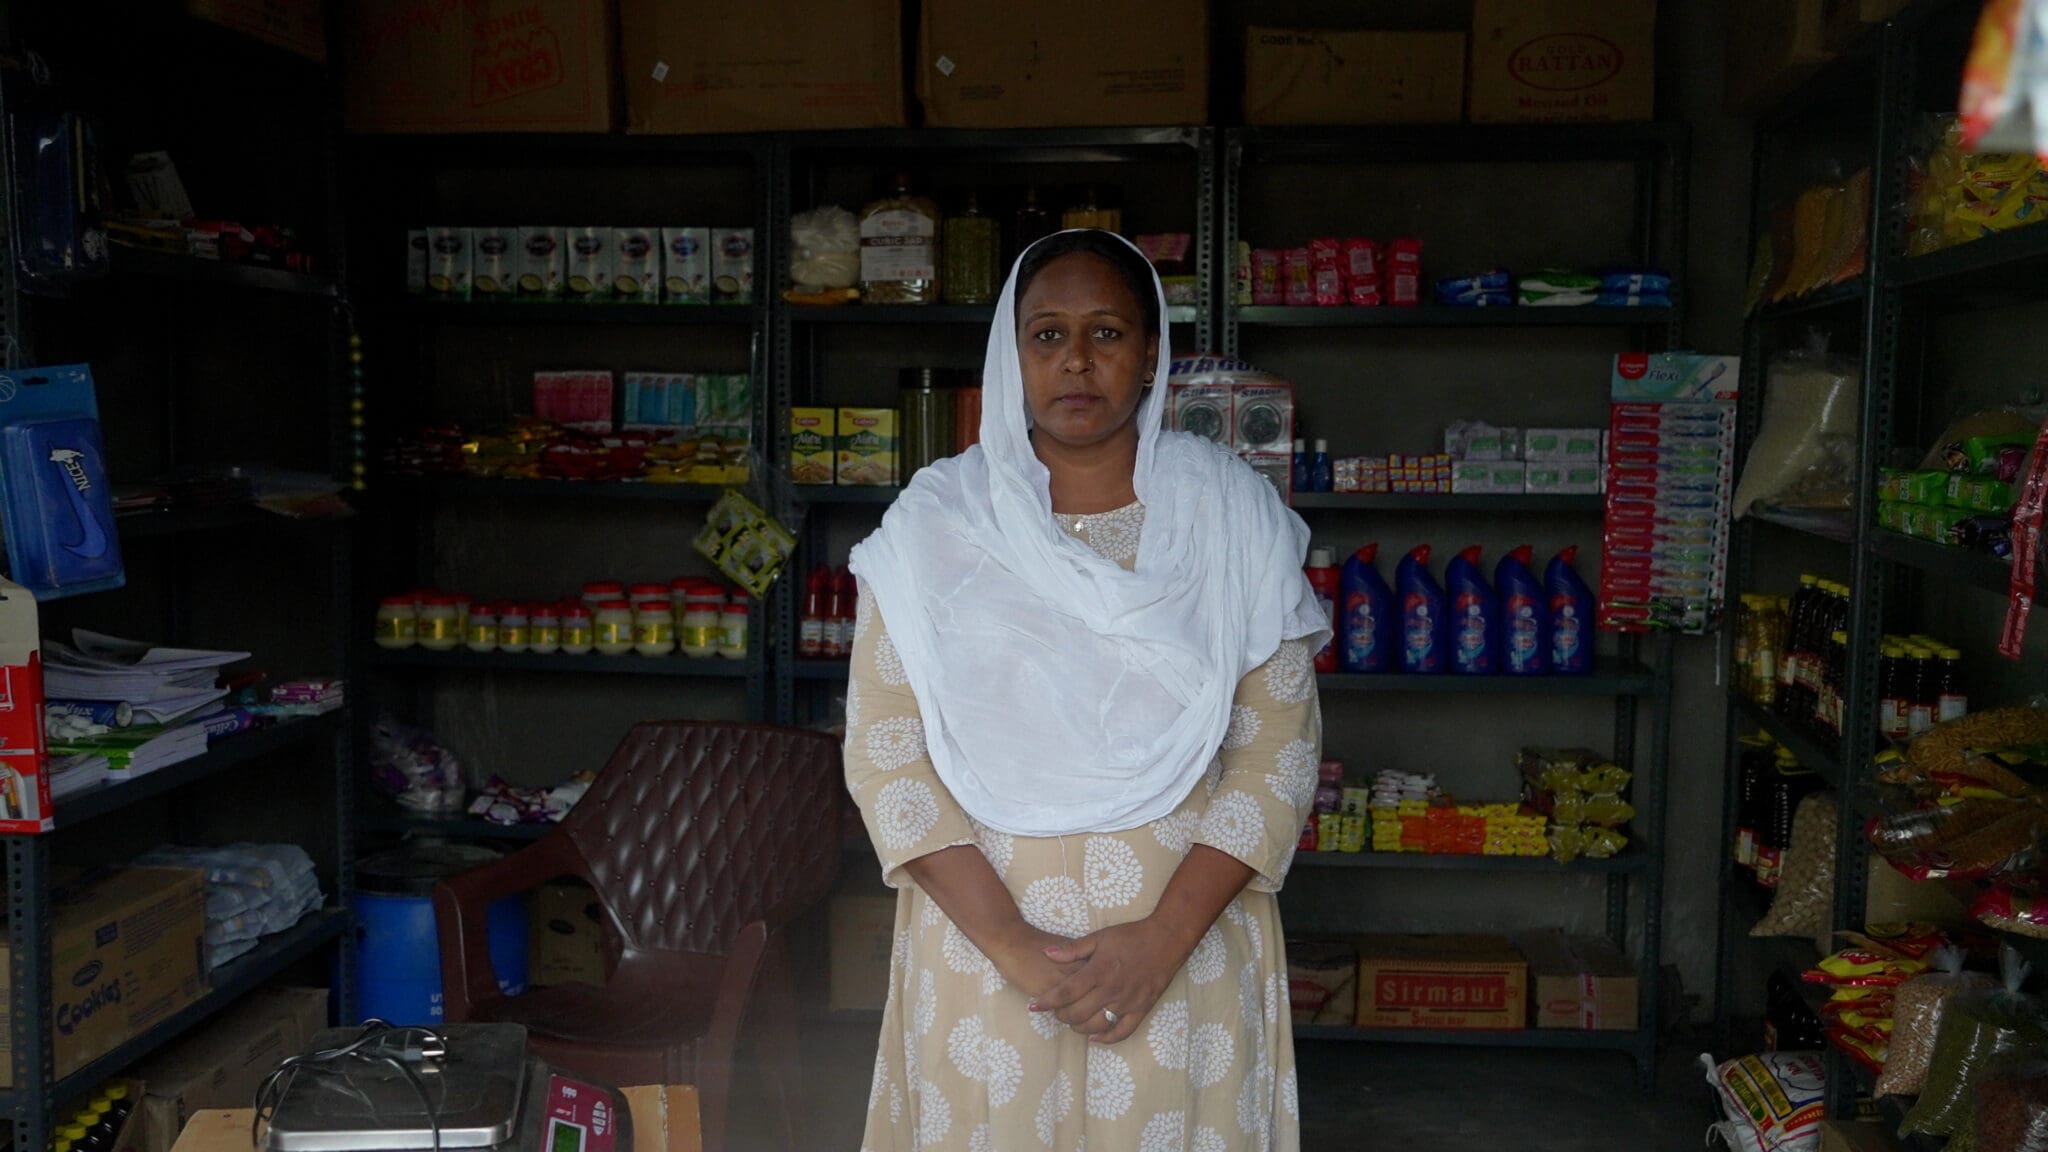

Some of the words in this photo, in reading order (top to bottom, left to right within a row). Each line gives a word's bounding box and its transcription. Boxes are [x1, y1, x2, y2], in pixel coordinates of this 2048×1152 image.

[1518, 55, 1612, 72] RATTAN
[1649, 369, 1680, 382] Flexi
[64, 459, 91, 492] NICE
[1382, 980, 1500, 1003] Sirmaur
[57, 978, 121, 1036] Cookies
